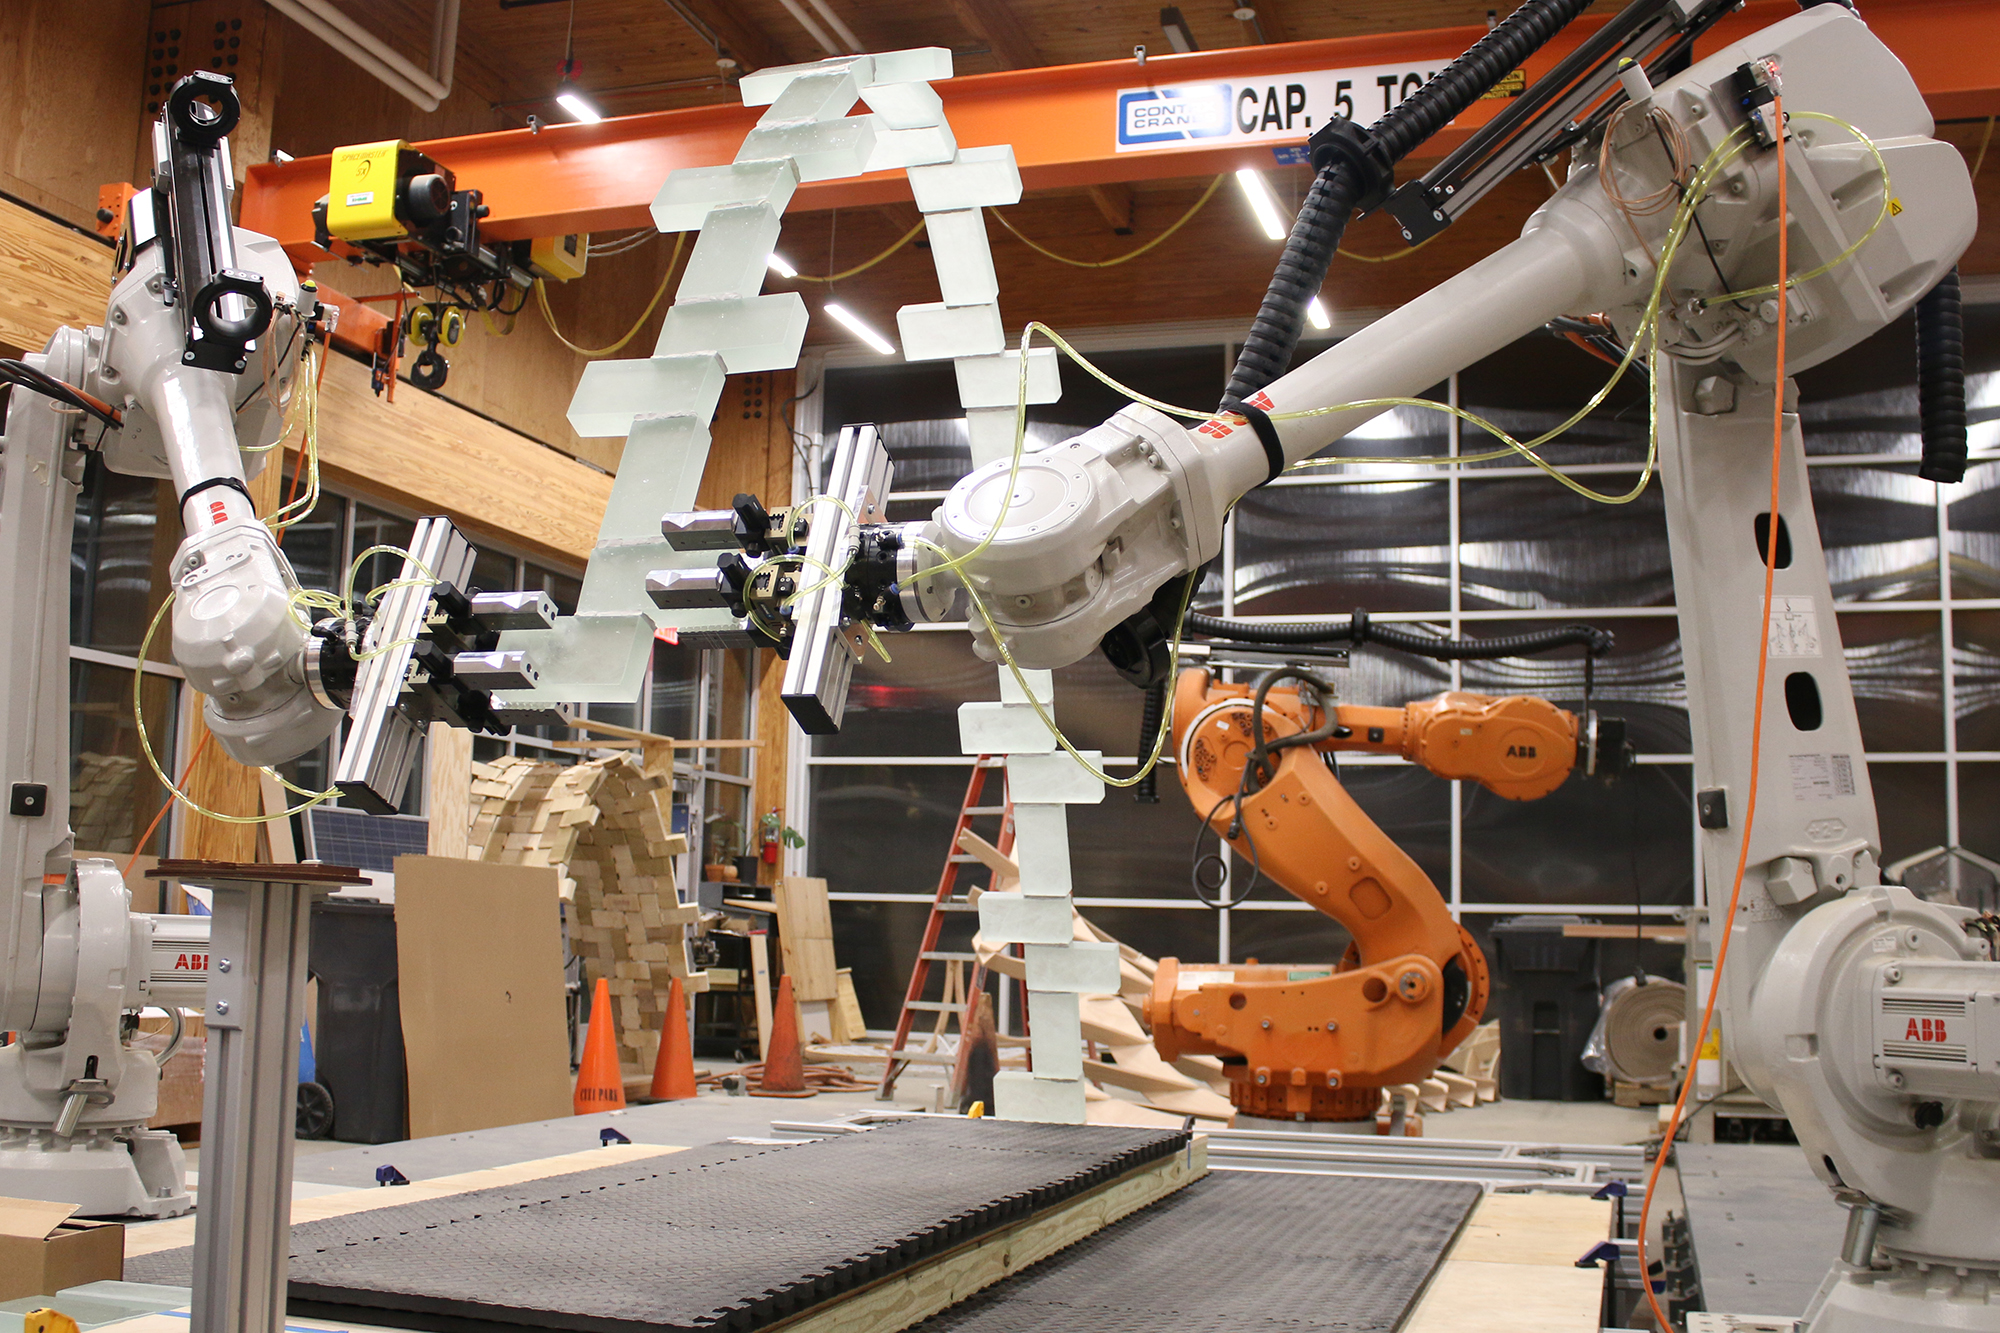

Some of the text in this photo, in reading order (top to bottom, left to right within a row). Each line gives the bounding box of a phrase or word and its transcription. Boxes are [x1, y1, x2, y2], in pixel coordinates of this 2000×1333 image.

[1237, 84, 1311, 134] CAP.
[1334, 80, 1353, 120] 5
[1377, 71, 1436, 113] TO
[1506, 745, 1537, 758] ABB
[1905, 1017, 1947, 1042] ABB
